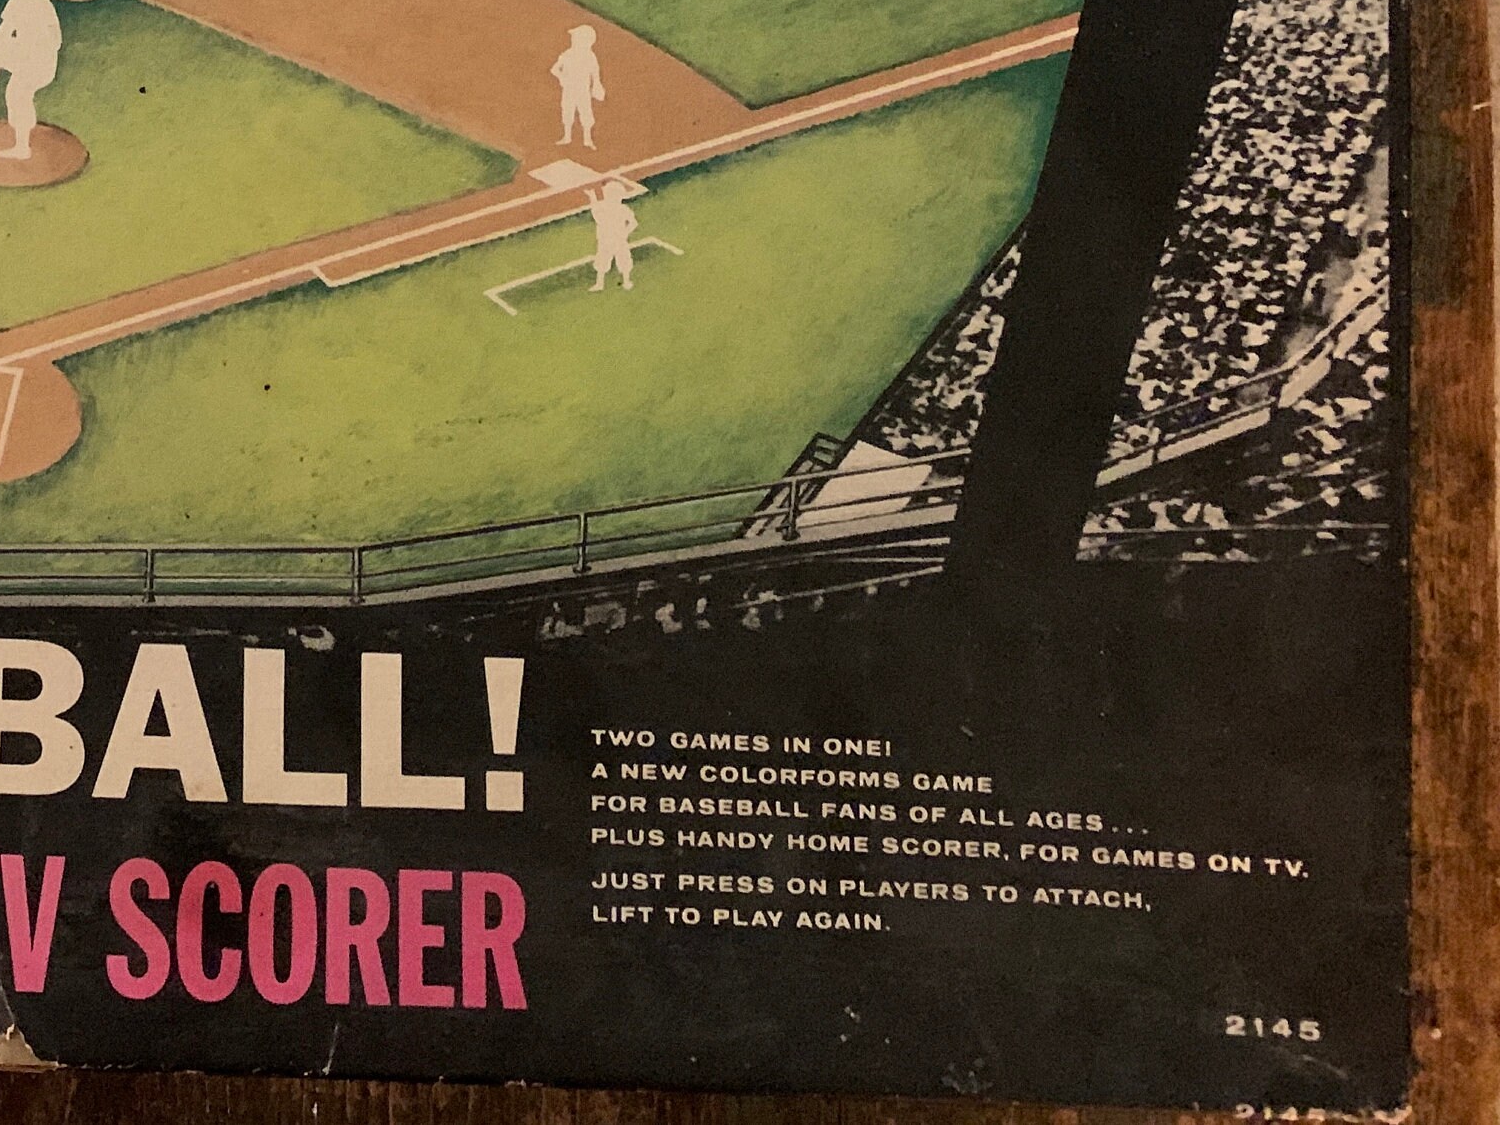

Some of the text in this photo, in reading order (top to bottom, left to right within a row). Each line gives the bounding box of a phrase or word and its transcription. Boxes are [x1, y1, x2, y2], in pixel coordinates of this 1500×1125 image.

[590, 729, 656, 748] TWO
[669, 731, 770, 753] GAMES
[783, 736, 811, 754] IN
[591, 762, 993, 794] A NEW COLORFORMS GAME
[591, 795, 647, 813] FOR
[659, 796, 809, 818] BASEBALL
[821, 802, 897, 822] FANS
[908, 805, 947, 824] OF
[958, 807, 1015, 827] ALL
[591, 827, 1309, 879] PLUS HANDY HOME SCORER, FOR GAMES ON TV.
[591, 872, 1152, 912] JUST PRESS ON PLAYERS TO ATTACH,
[105, 856, 530, 1011] SCORER
[592, 905, 891, 931] LIFT TO PLAY AGAIN.
[1224, 1014, 1321, 1042] 2145
